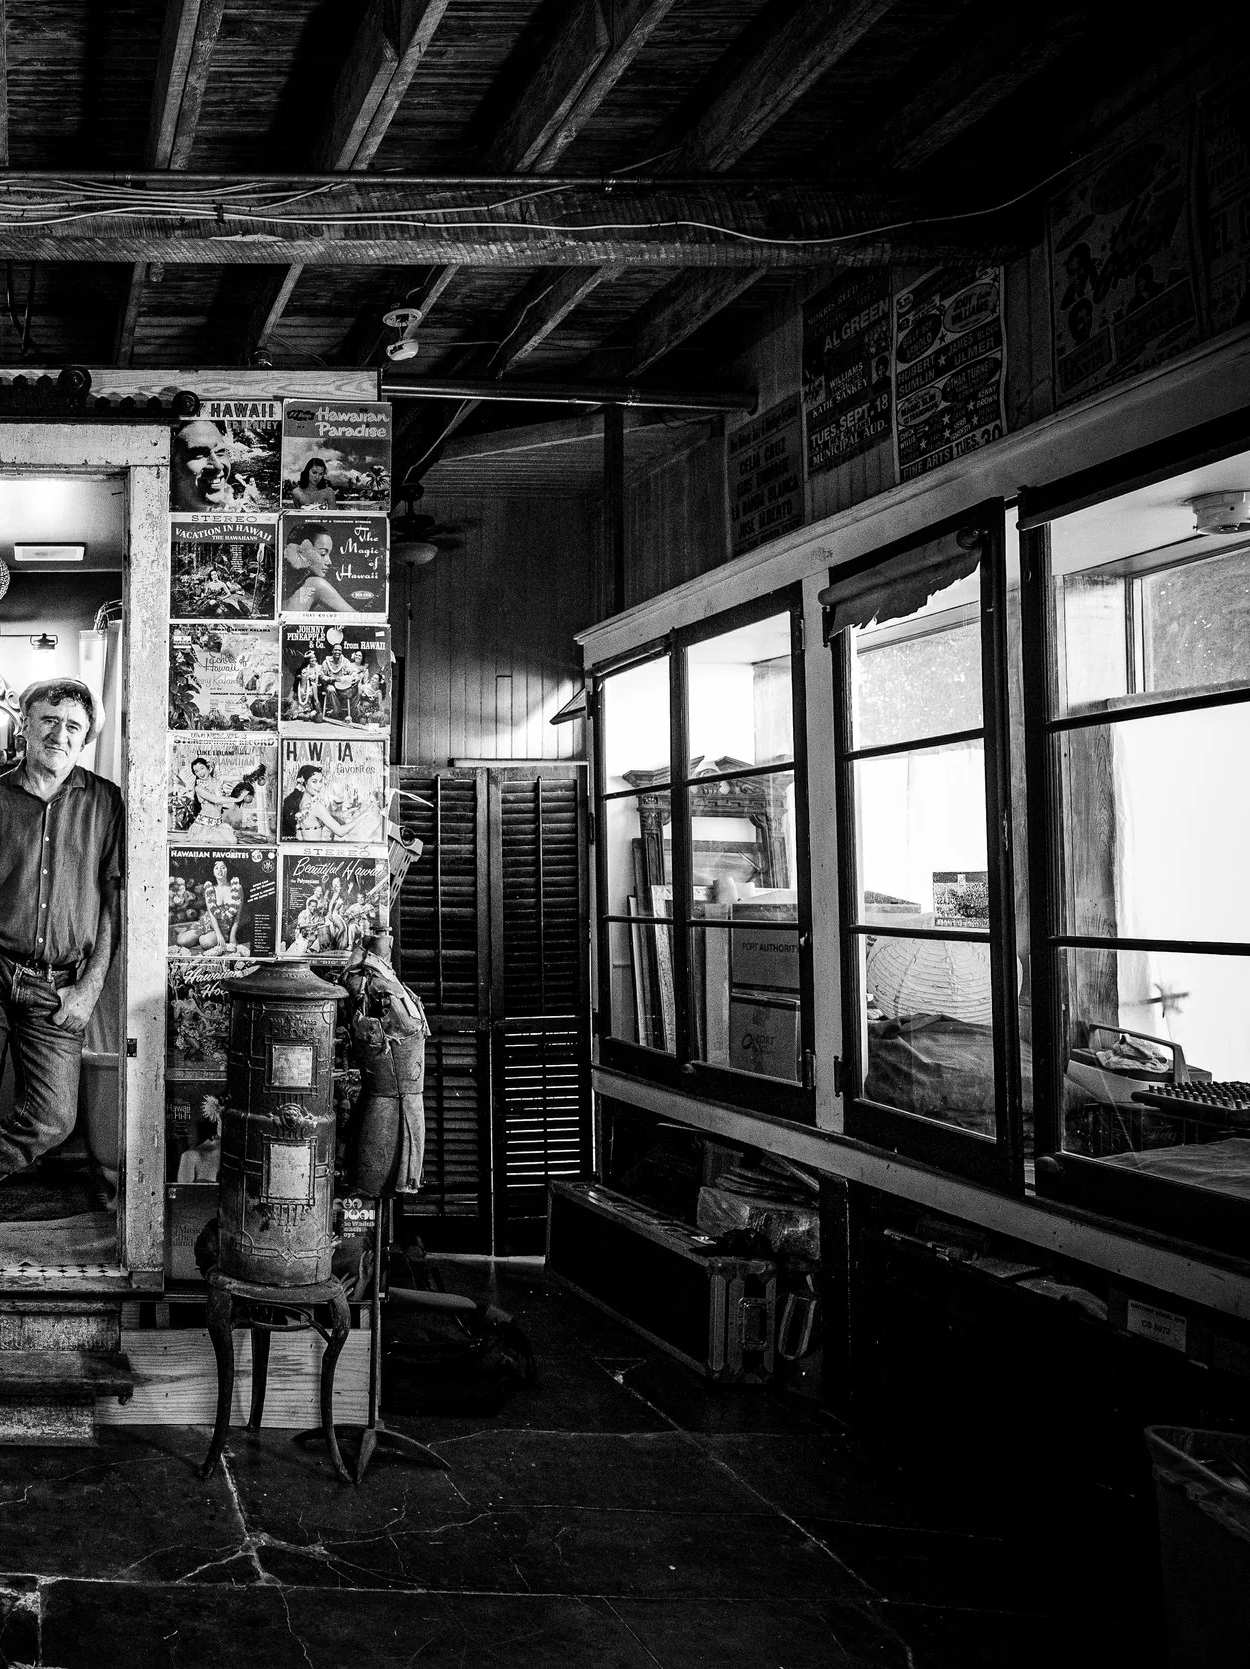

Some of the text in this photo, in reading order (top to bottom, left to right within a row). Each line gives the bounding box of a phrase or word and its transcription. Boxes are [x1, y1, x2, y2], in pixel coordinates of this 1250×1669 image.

[823, 330, 841, 354] AL
[841, 296, 890, 340] GREEN
[976, 322, 999, 341] BLOOD
[954, 337, 995, 366] ULMER
[828, 361, 864, 389] WILLIAMS
[897, 354, 936, 384] HUBERT
[967, 359, 995, 380] TURNER
[898, 369, 936, 397] SUMLIN
[812, 377, 869, 418] KATIE SANKEY
[210, 403, 274, 418] HAWAII
[315, 406, 390, 423] Hawaiian
[839, 402, 875, 431] SEPT.
[875, 393, 889, 413] 18
[314, 421, 387, 438] Paradise
[811, 419, 889, 467] MUNICIPAL AUD.
[739, 436, 786, 476] CELIA CRUZ
[902, 448, 952, 480] FINE ARTS
[768, 475, 799, 502] BLANCA
[191, 515, 258, 523] STEREO
[739, 499, 793, 539] JOSE ALBERTO
[175, 524, 273, 541] VACATION IN HAWAII
[354, 525, 379, 542] The
[339, 537, 379, 558] Magic
[335, 563, 379, 581] Hawaii
[368, 556, 379, 570] of
[287, 633, 326, 641] PINEAPPLE
[296, 626, 326, 634] JOHNNY
[316, 641, 326, 649] Co.
[343, 641, 386, 650] from HAWAII
[239, 738, 275, 746] RECORD
[336, 763, 376, 774] favorites
[170, 850, 249, 859] HAWAIIAN FAVORITES
[303, 848, 370, 857] STEREO
[293, 857, 385, 883] Beautiful Hawaii
[166, 1103, 191, 1113] Hawaii
